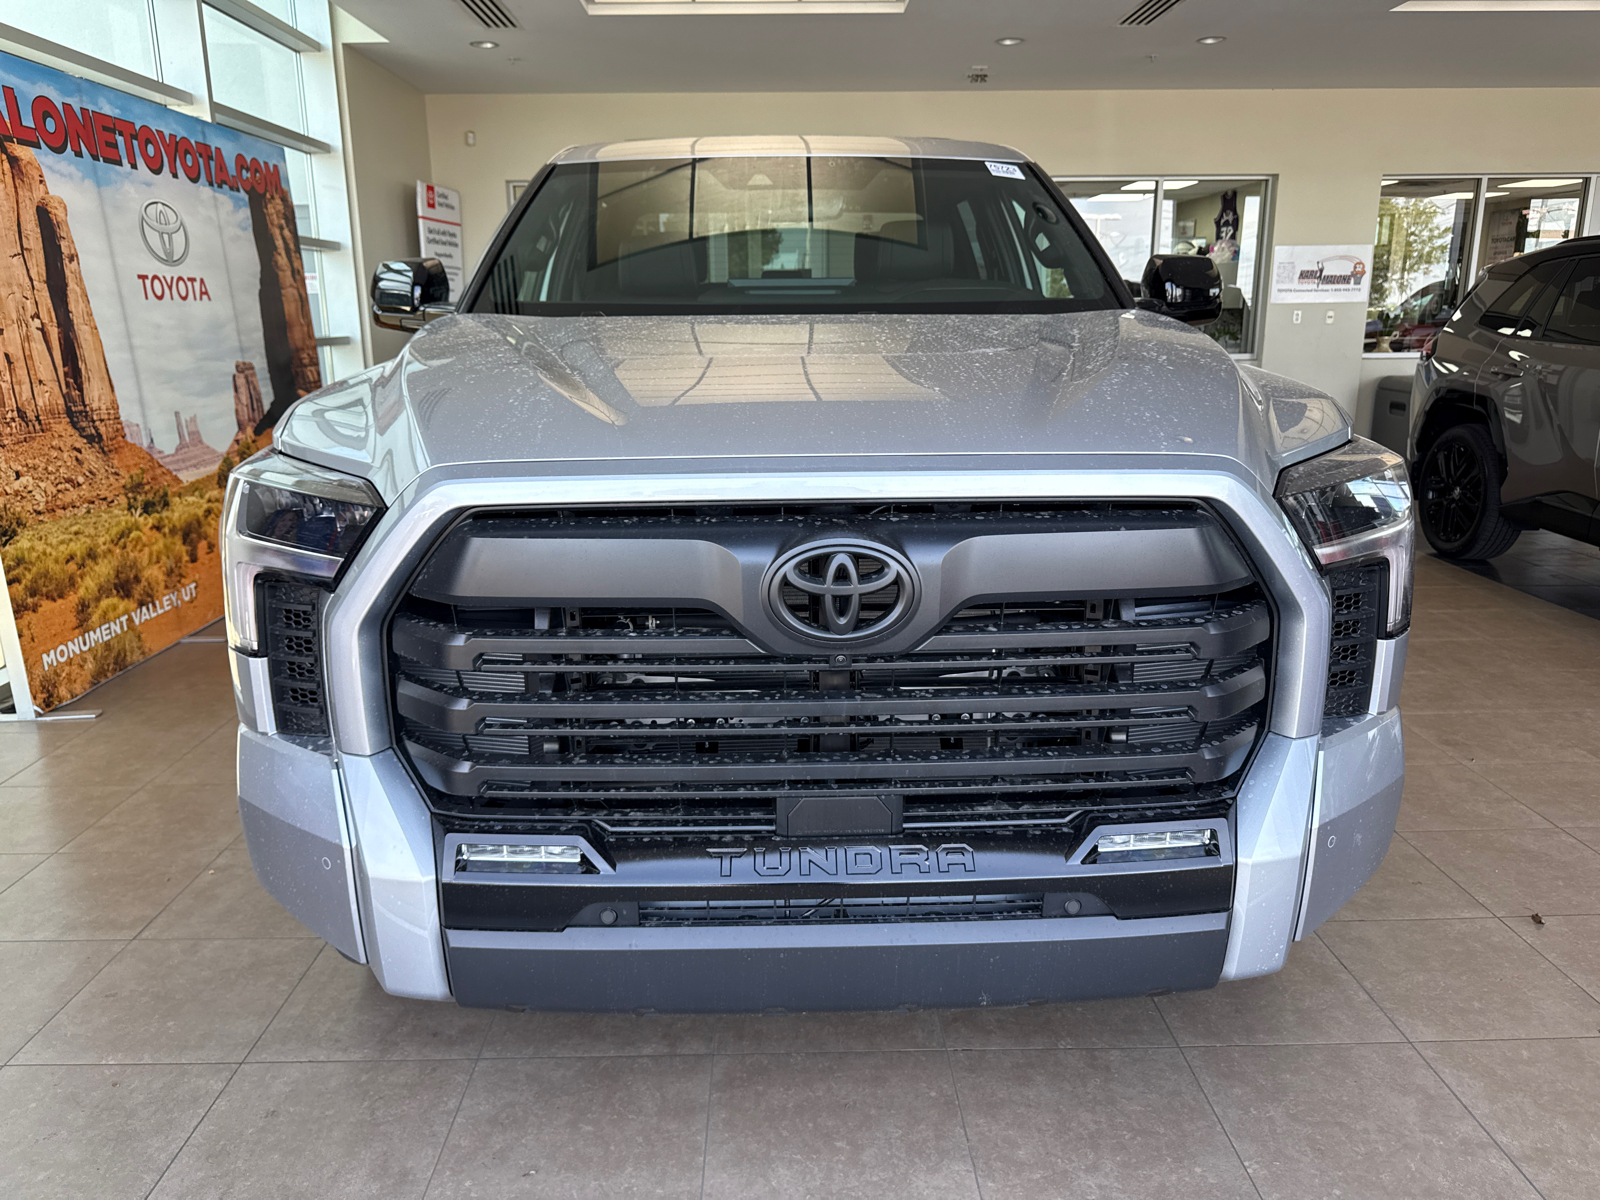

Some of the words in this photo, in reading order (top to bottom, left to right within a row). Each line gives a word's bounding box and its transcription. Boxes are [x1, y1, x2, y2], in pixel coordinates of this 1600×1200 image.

[137, 274, 212, 301] TOYOTA
[1298, 269, 1319, 280] KARL
[1321, 274, 1352, 285] MALONE
[41, 614, 128, 671] MONUMENT
[131, 591, 181, 626] VALLEY,
[181, 582, 197, 601] UT
[706, 843, 976, 877] TUNDRA
